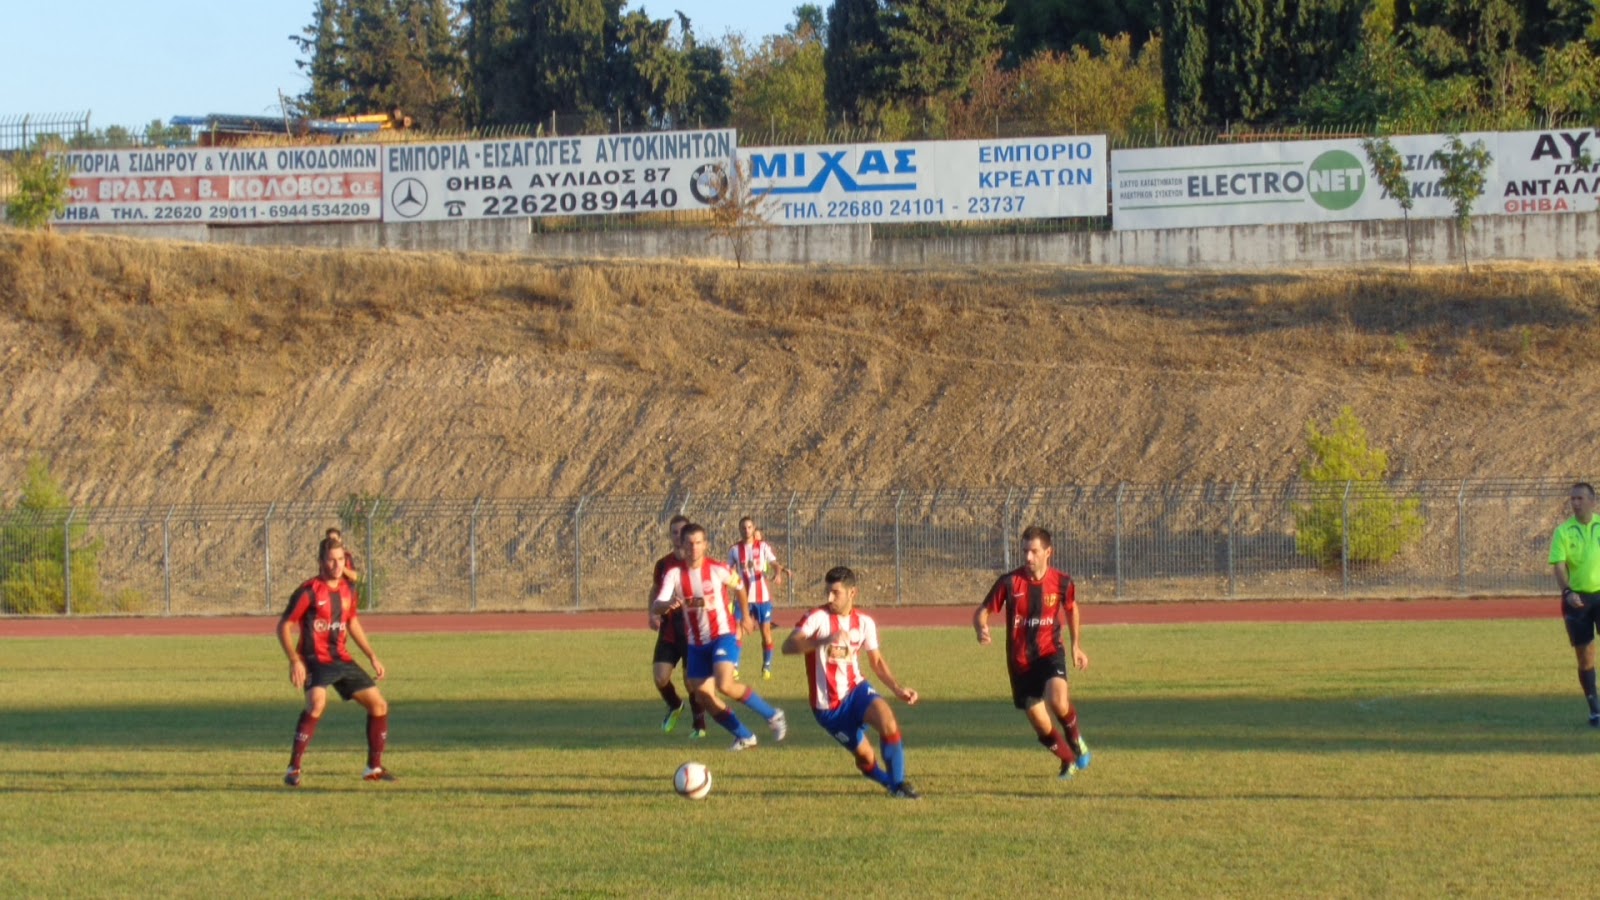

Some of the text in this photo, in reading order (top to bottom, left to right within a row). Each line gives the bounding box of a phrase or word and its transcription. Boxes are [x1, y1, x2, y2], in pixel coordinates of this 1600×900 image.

[129, 152, 197, 172] ΣΙΔΗΡΟΥ
[205, 156, 213, 171] &
[219, 151, 268, 171] ΥΛΙΚΑ
[277, 148, 377, 170] ΟΙΚΟΔΟΜΩΝ
[388, 144, 470, 173] ΕΜΠΟΡΙΑ
[483, 139, 582, 169] ΕΙΣΑΓΩΓΕΣ
[595, 132, 730, 164] ΑΥΤΟΚΙΝΗΤΩΝ
[979, 142, 1092, 163] ΕΜΠΟΡΙΟ
[446, 167, 671, 192] ΘΗΒΑ ΑΥΛΙΔΟΣ 87
[750, 149, 917, 195] ΜΙΧΑΣ
[979, 168, 1092, 188] ΚΡΕΑΤΩΝ
[99, 179, 175, 199] ΒΡΑΧΑ
[199, 179, 218, 198] Β.
[111, 207, 149, 219] ΤΗΛ.
[154, 206, 202, 219] 22620
[209, 205, 257, 219] 29011
[482, 188, 678, 216] 2262089440
[783, 202, 823, 219] ΤΗΛ.
[827, 201, 883, 218] 22680
[889, 198, 944, 216] 24101
[968, 196, 1025, 214] 23737
[1504, 197, 1568, 213] ΘΗΒΑ
